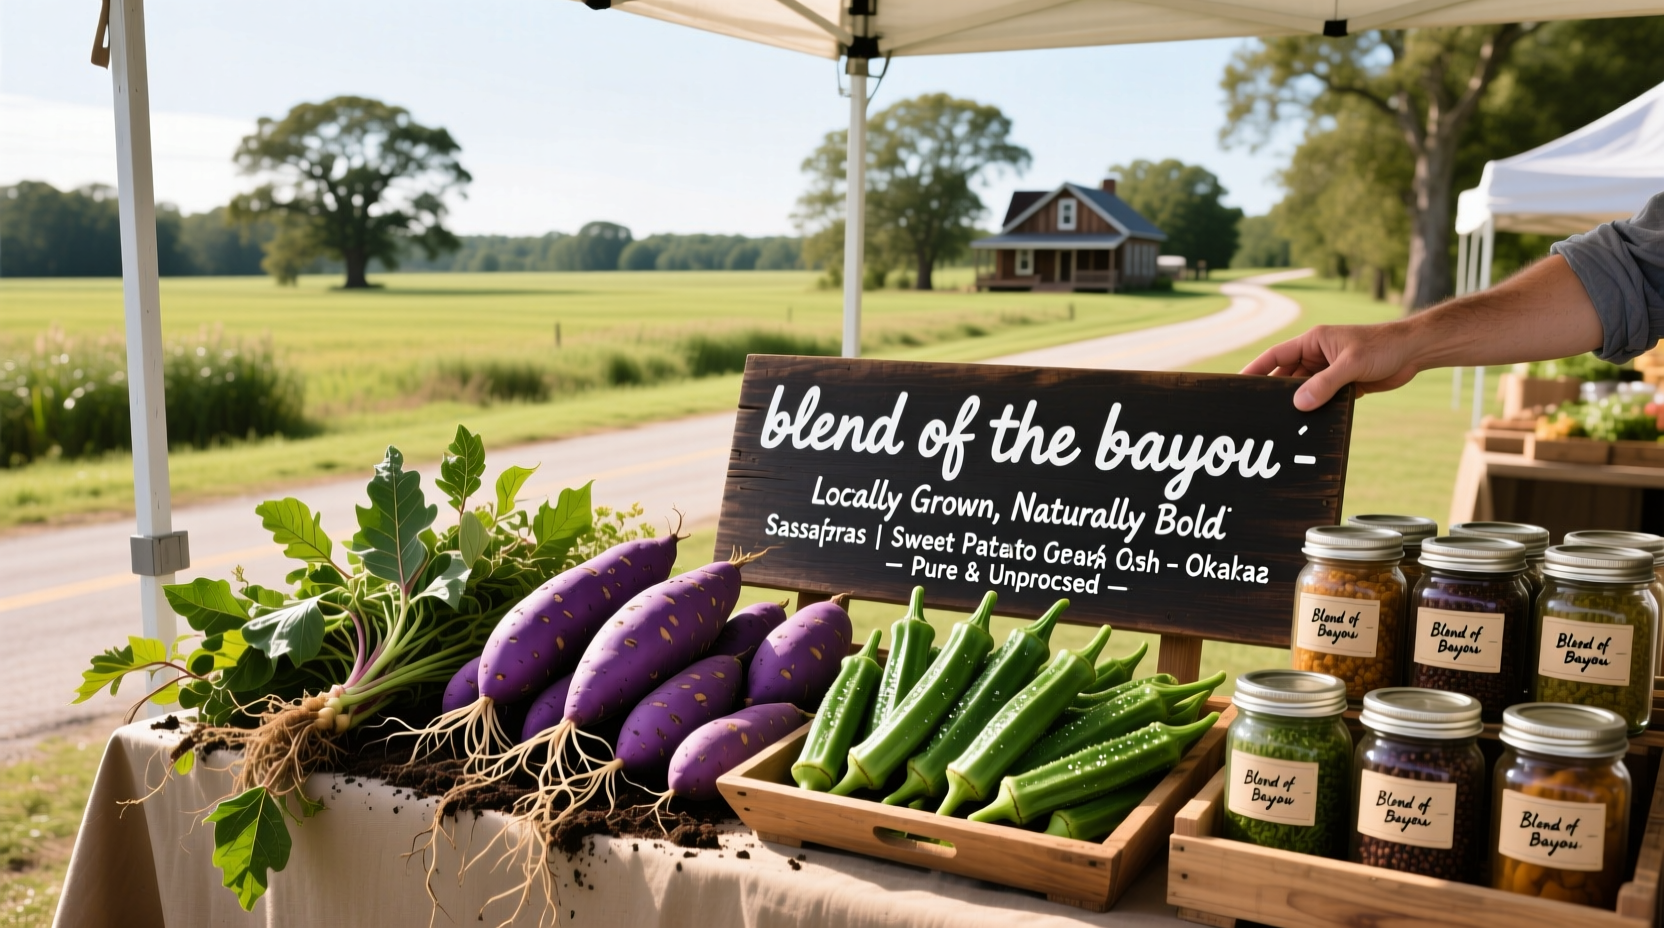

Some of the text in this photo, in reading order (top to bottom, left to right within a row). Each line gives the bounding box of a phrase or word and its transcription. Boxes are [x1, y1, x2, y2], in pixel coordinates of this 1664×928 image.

[760, 384, 909, 456] blend
[917, 394, 981, 482] of
[989, 399, 1082, 467] the
[1094, 402, 1281, 501] bayou
[811, 475, 903, 522] Locally
[910, 483, 1001, 525] Grown,
[1010, 490, 1146, 544] Naturally
[890, 525, 956, 553] Sweet
[910, 555, 958, 581] Pure
[964, 561, 980, 583] &
[989, 563, 1101, 595] Unprocsed
[1348, 611, 1361, 628] of
[1469, 625, 1484, 643] of
[1596, 636, 1612, 655] of
[1282, 775, 1297, 793] of
[1417, 796, 1433, 816] of
[1565, 817, 1581, 837] of
